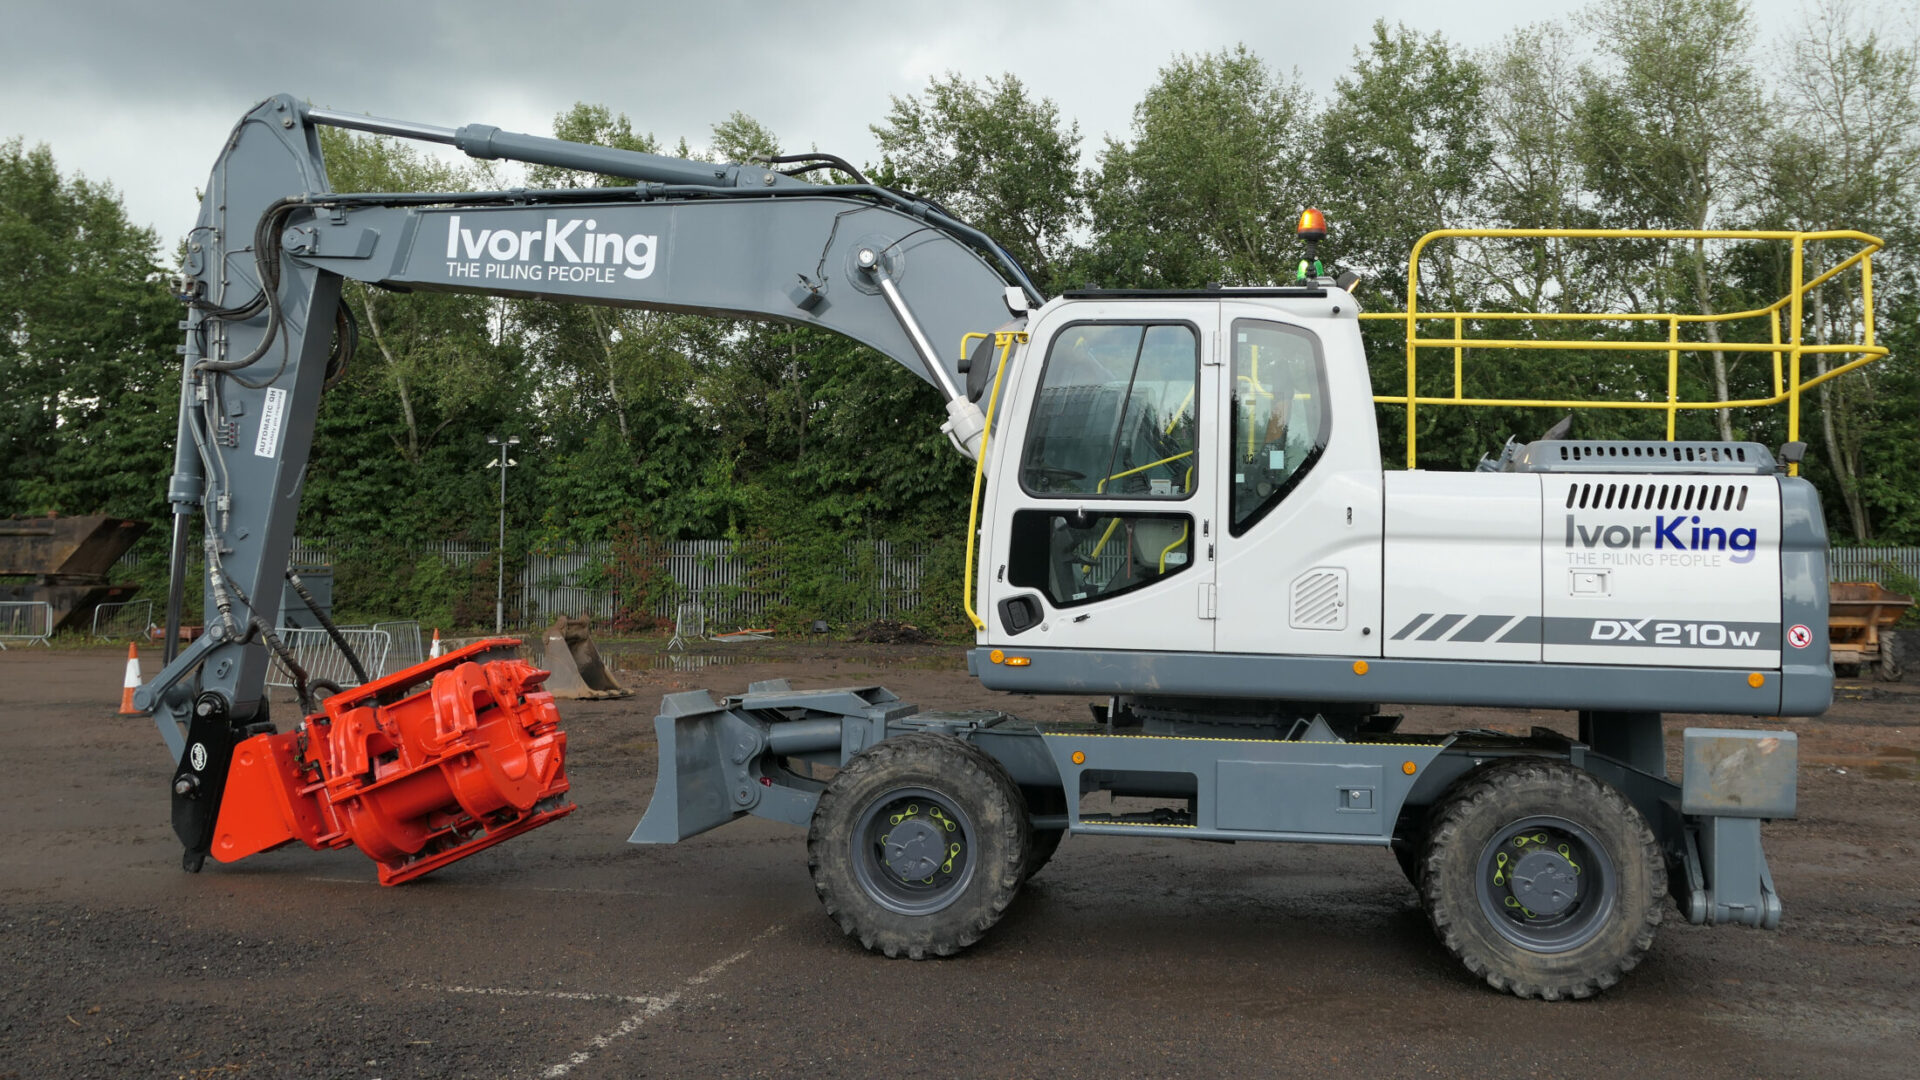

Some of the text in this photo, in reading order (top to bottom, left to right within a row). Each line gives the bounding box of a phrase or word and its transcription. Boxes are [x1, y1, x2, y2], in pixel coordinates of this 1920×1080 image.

[446, 215, 658, 280] IvorKing
[446, 261, 616, 284] THE PILING PEOPLE
[259, 405, 273, 453] AUTOMATIC
[1565, 514, 1757, 565] IvorKing
[1566, 552, 1721, 568] THE PILING PEOPLE
